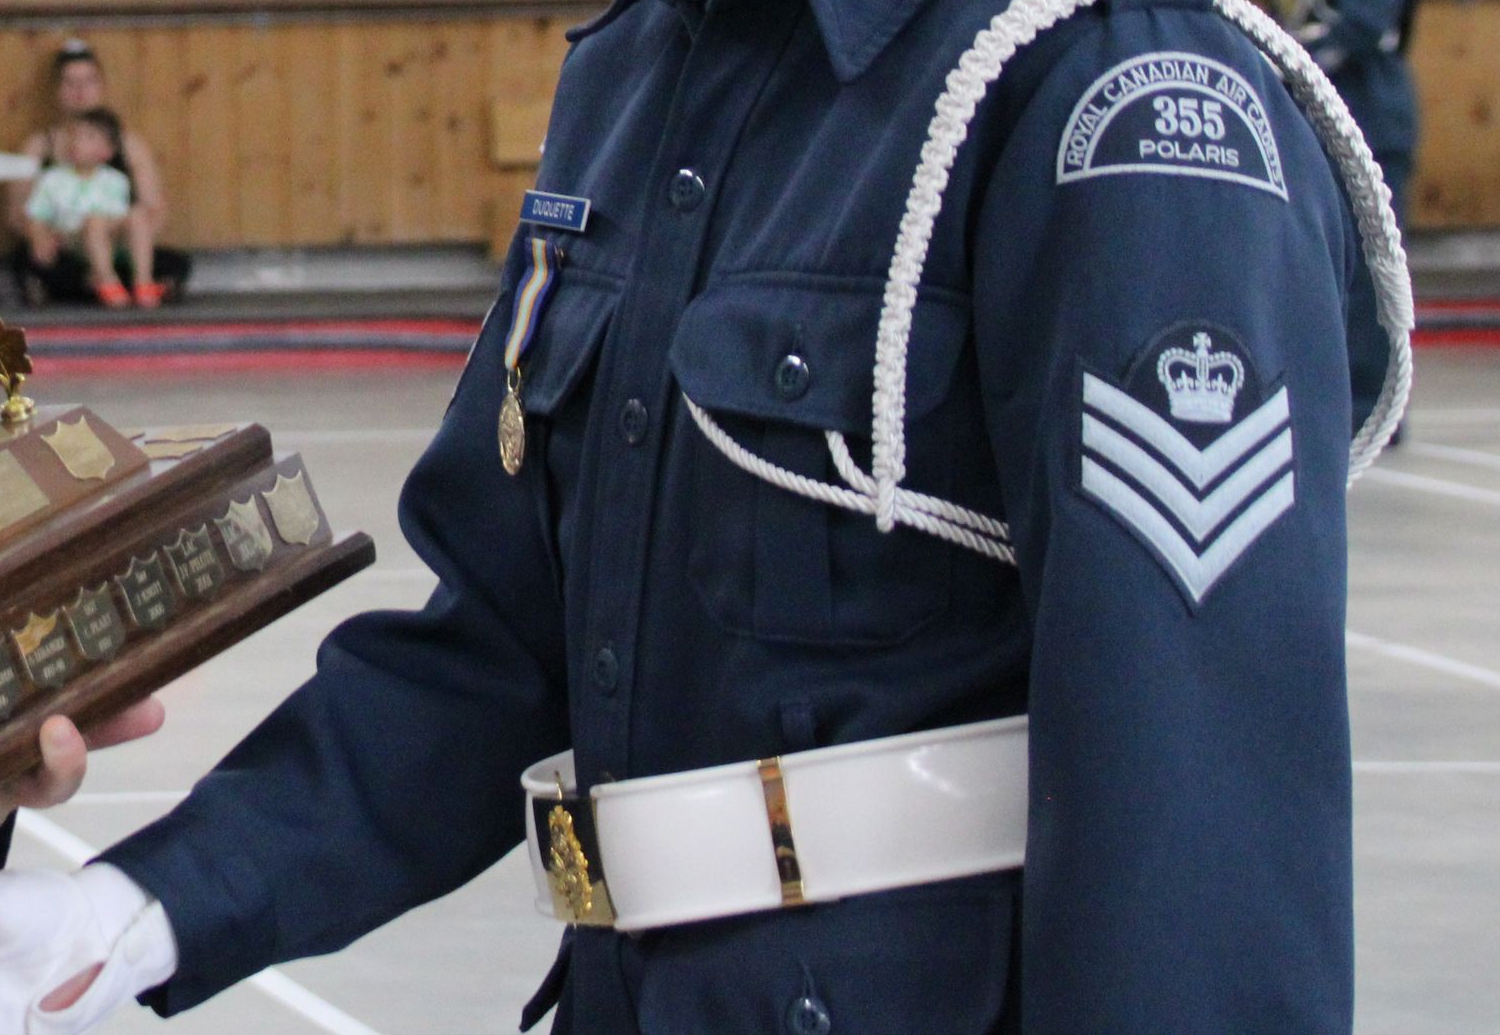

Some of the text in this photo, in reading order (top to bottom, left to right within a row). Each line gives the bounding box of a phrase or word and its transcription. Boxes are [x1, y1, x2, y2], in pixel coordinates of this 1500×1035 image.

[1066, 60, 1283, 183] ROYAL CANADIAN AIR CADETS
[1152, 95, 1226, 141] 355
[1139, 139, 1240, 168] POLARIS
[532, 198, 576, 221] DUQUETTE
